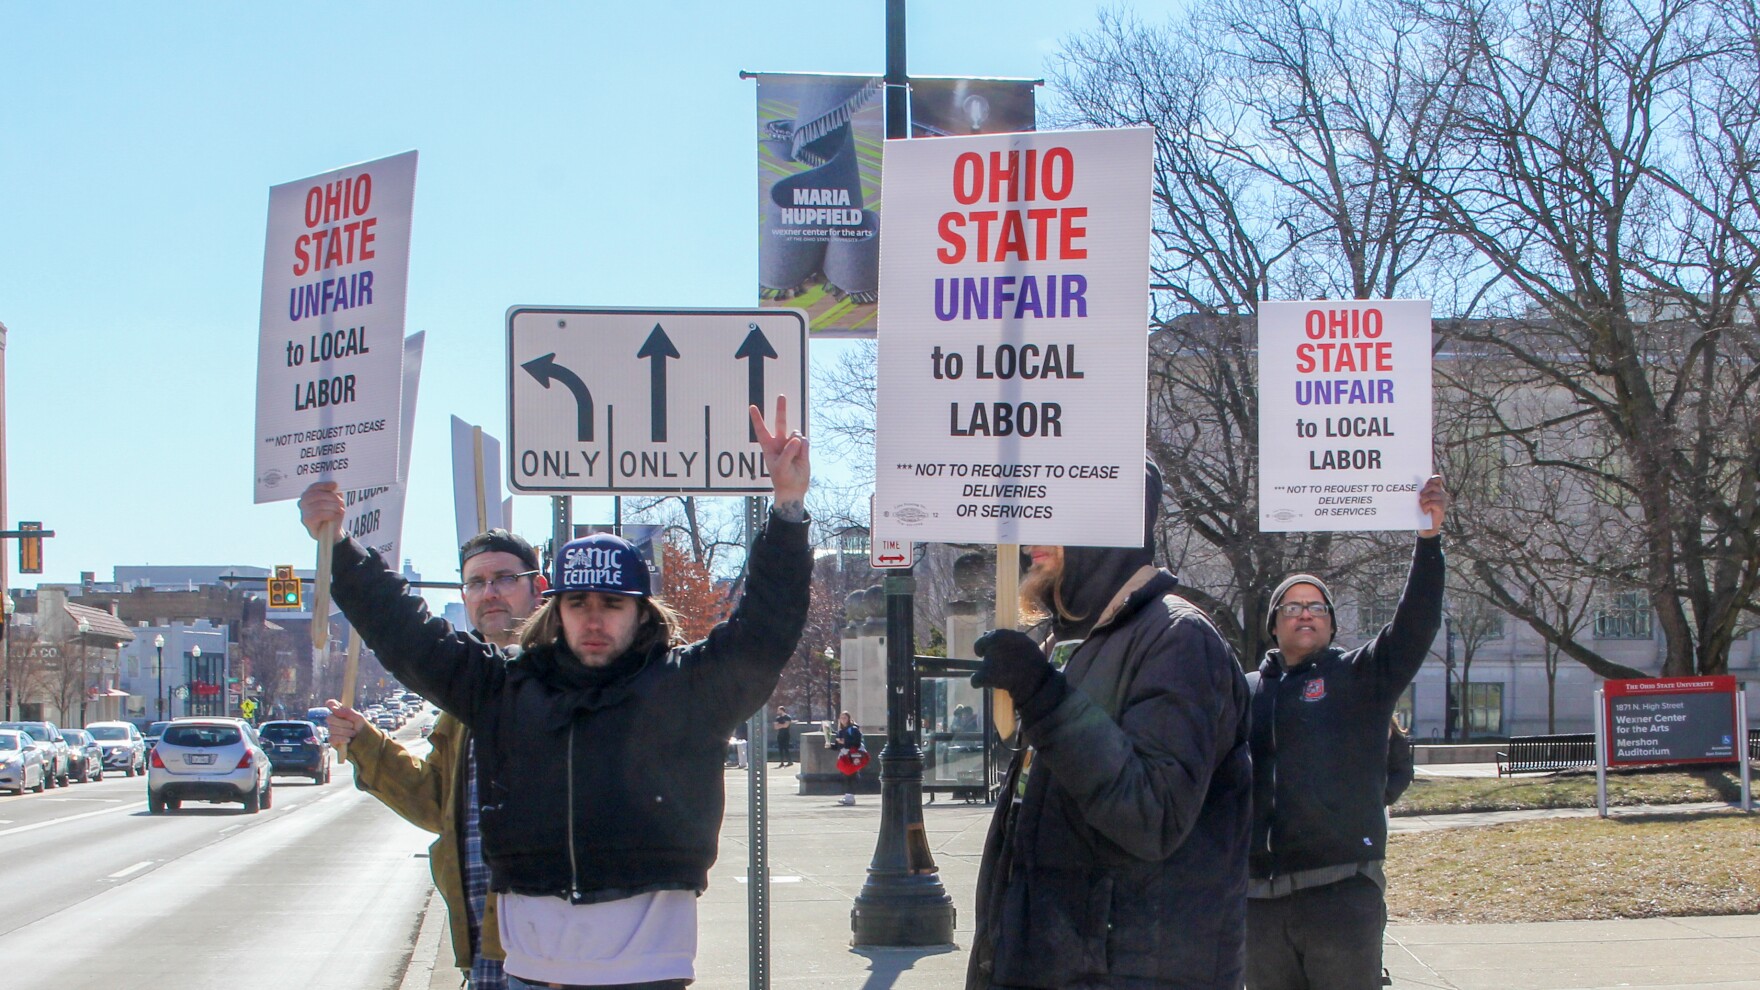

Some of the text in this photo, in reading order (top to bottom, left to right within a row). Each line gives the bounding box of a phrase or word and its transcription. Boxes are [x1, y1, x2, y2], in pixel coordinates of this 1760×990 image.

[953, 147, 1074, 205] OHIO
[305, 173, 372, 229] OHIO
[793, 188, 850, 206] MARIA
[781, 208, 863, 226] HUPFIELD
[829, 228, 840, 236] for
[842, 229, 855, 237] the
[937, 207, 1087, 264] STATE
[293, 217, 377, 277] STATE
[289, 270, 374, 322] UNFAIR
[934, 274, 1088, 321] UNFAIR
[1305, 308, 1383, 340] OHIO
[286, 326, 369, 367] to LOCAL
[931, 344, 1084, 380] to LOCAL
[1296, 342, 1393, 374] STATE
[295, 374, 356, 412] LABOR
[1295, 379, 1394, 406] UNFAIR
[950, 402, 1062, 438] LABOR
[1296, 417, 1395, 438] to LOCAL
[275, 434, 292, 446] NOT
[294, 432, 304, 444] TO
[305, 426, 343, 442] REQUEST
[345, 423, 356, 435] TO
[357, 419, 386, 434] CEASE
[300, 442, 346, 459] DELIVERIES
[1309, 449, 1382, 470] LABOR
[297, 458, 349, 476] OR SERVICES
[521, 450, 770, 478] ONLY ONLY ONL
[915, 464, 946, 477] NOT
[949, 464, 968, 477] TO
[971, 464, 1042, 478] REQUEST
[1045, 465, 1065, 478] TO
[1068, 465, 1119, 479] CEASE
[962, 484, 1047, 498] DELIVERIES
[1286, 485, 1307, 494] NOT
[1309, 485, 1322, 494] TO
[1323, 484, 1370, 493] REQUEST
[1371, 484, 1384, 493] TO
[1385, 483, 1418, 492] CEASE
[1318, 496, 1373, 505] DELIVERIES
[956, 504, 1053, 519] OR SERVICES
[1314, 507, 1377, 516] OR SERVICES
[883, 541, 900, 550] TIME
[564, 548, 622, 570] SNIC
[564, 569, 622, 585] TEMPLE
[1632, 703, 1641, 711] N.
[1642, 703, 1660, 712] High
[1661, 702, 1684, 710] Street
[1616, 714, 1686, 724] Wexner Center
[1616, 724, 1669, 734] for the Arts
[1617, 738, 1658, 747] Mershon
[1617, 747, 1670, 757] Auditorium
